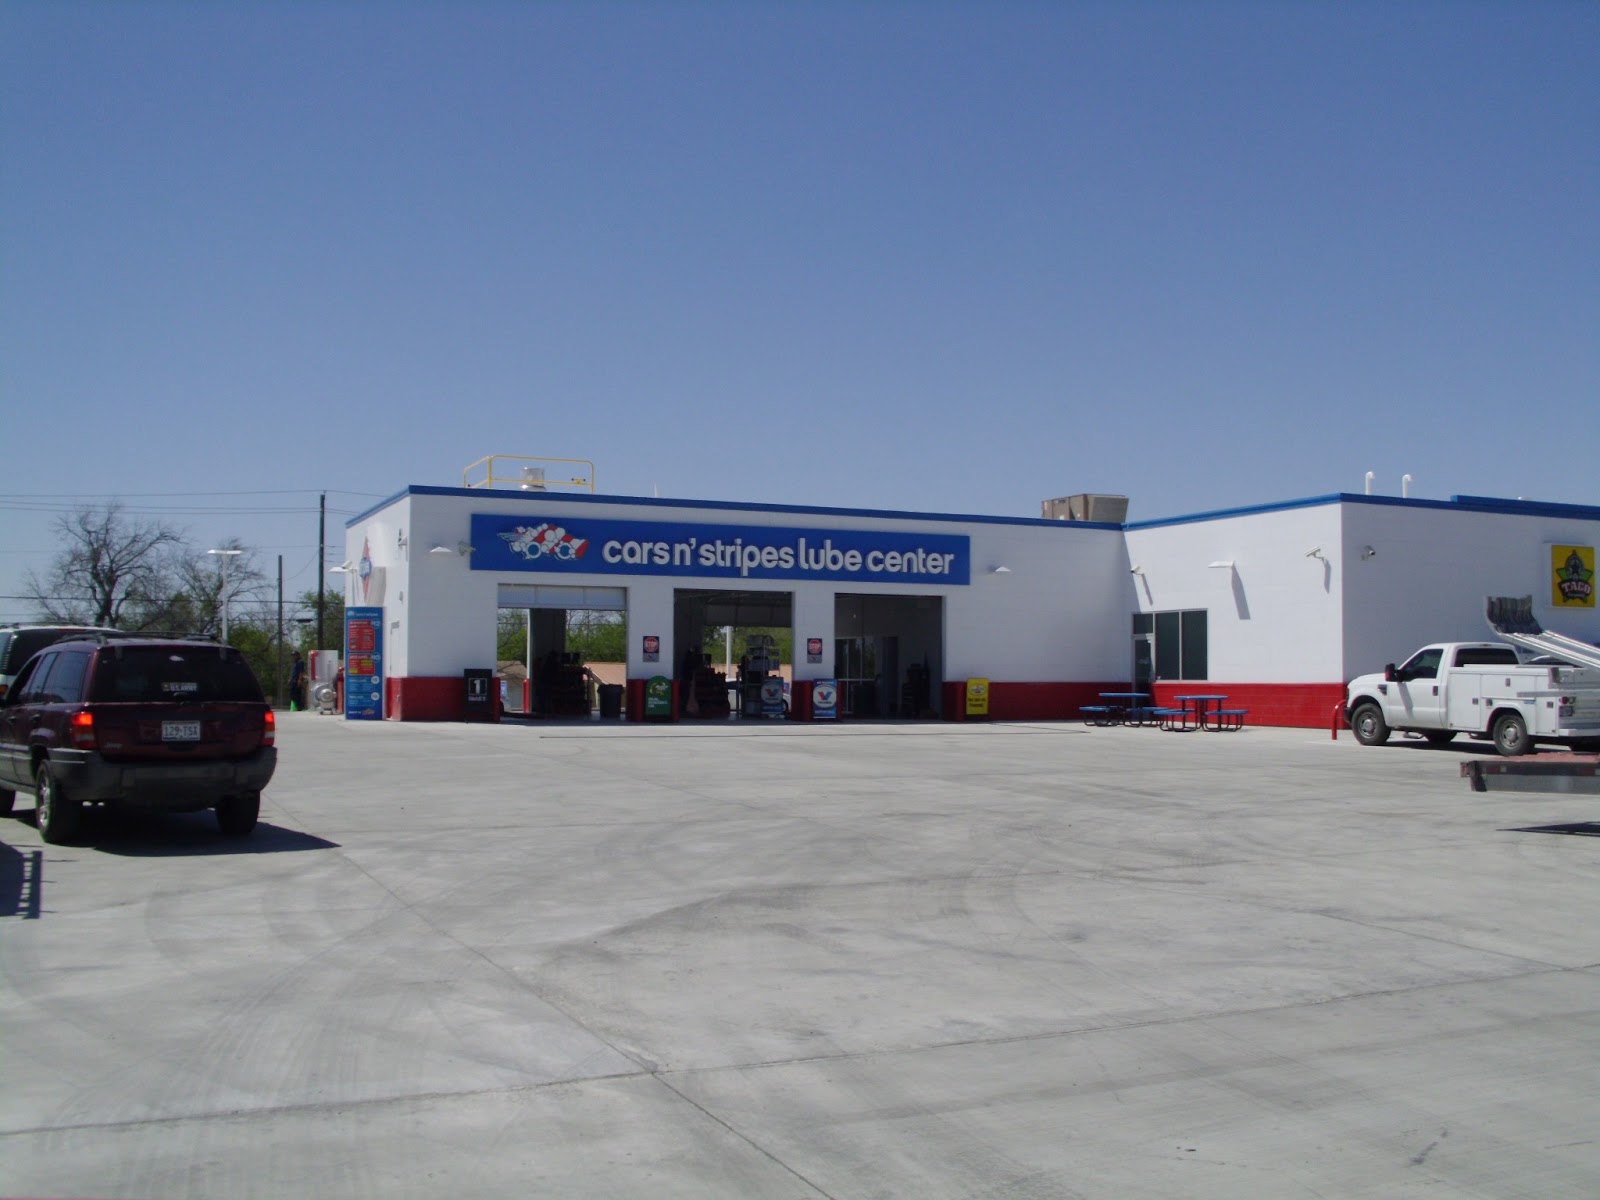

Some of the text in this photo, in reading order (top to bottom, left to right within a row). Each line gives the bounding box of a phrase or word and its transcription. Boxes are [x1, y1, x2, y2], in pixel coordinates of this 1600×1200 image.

[602, 540, 671, 565] cars
[699, 538, 795, 577] stripes
[798, 537, 862, 572] lube
[867, 548, 954, 574] center
